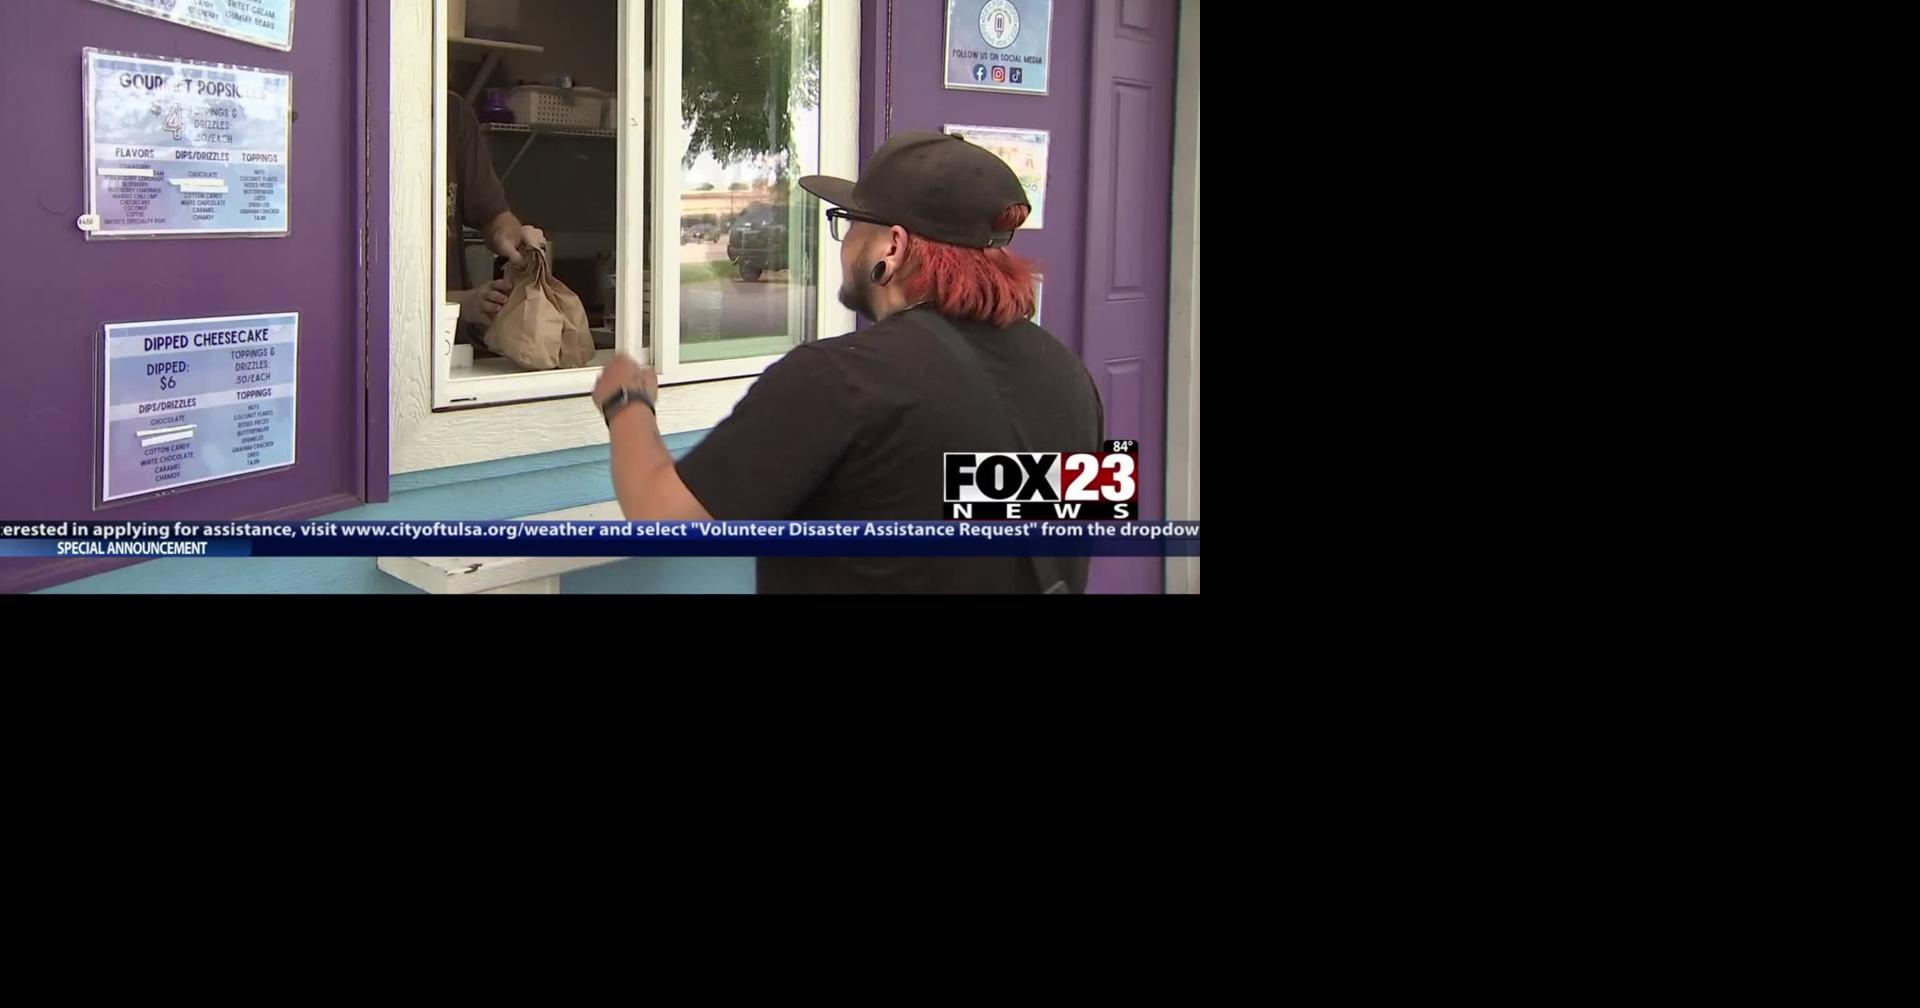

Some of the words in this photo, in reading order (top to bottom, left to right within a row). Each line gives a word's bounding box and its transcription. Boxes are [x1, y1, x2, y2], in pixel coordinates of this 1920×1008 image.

[227, 1, 250, 12] SWEET
[251, 6, 275, 18] CREAM
[952, 49, 978, 59] FOLLOW
[980, 51, 988, 60] US
[1001, 54, 1021, 62] SOCIAL
[115, 147, 154, 159] FLAVORS
[175, 150, 230, 161] DIPS/DRIZZLES
[241, 152, 278, 163] TOPPINGS
[144, 335, 189, 351] DIPPED
[193, 328, 269, 347] CHEESECAKE
[231, 348, 268, 360] TOPPINGS
[270, 347, 275, 356] &
[147, 361, 190, 376] DIPPED:
[160, 375, 177, 391] $6
[235, 372, 271, 384] .50/EACH
[236, 388, 272, 400] TOPPINGS
[139, 398, 196, 414] DIPS/DRIZZLES
[150, 415, 185, 426] CHOCOLATE
[144, 446, 170, 456] COTTON
[170, 443, 190, 451] CANDY
[159, 451, 194, 463] CHOCOLATE
[155, 472, 180, 482] CHAMOY
